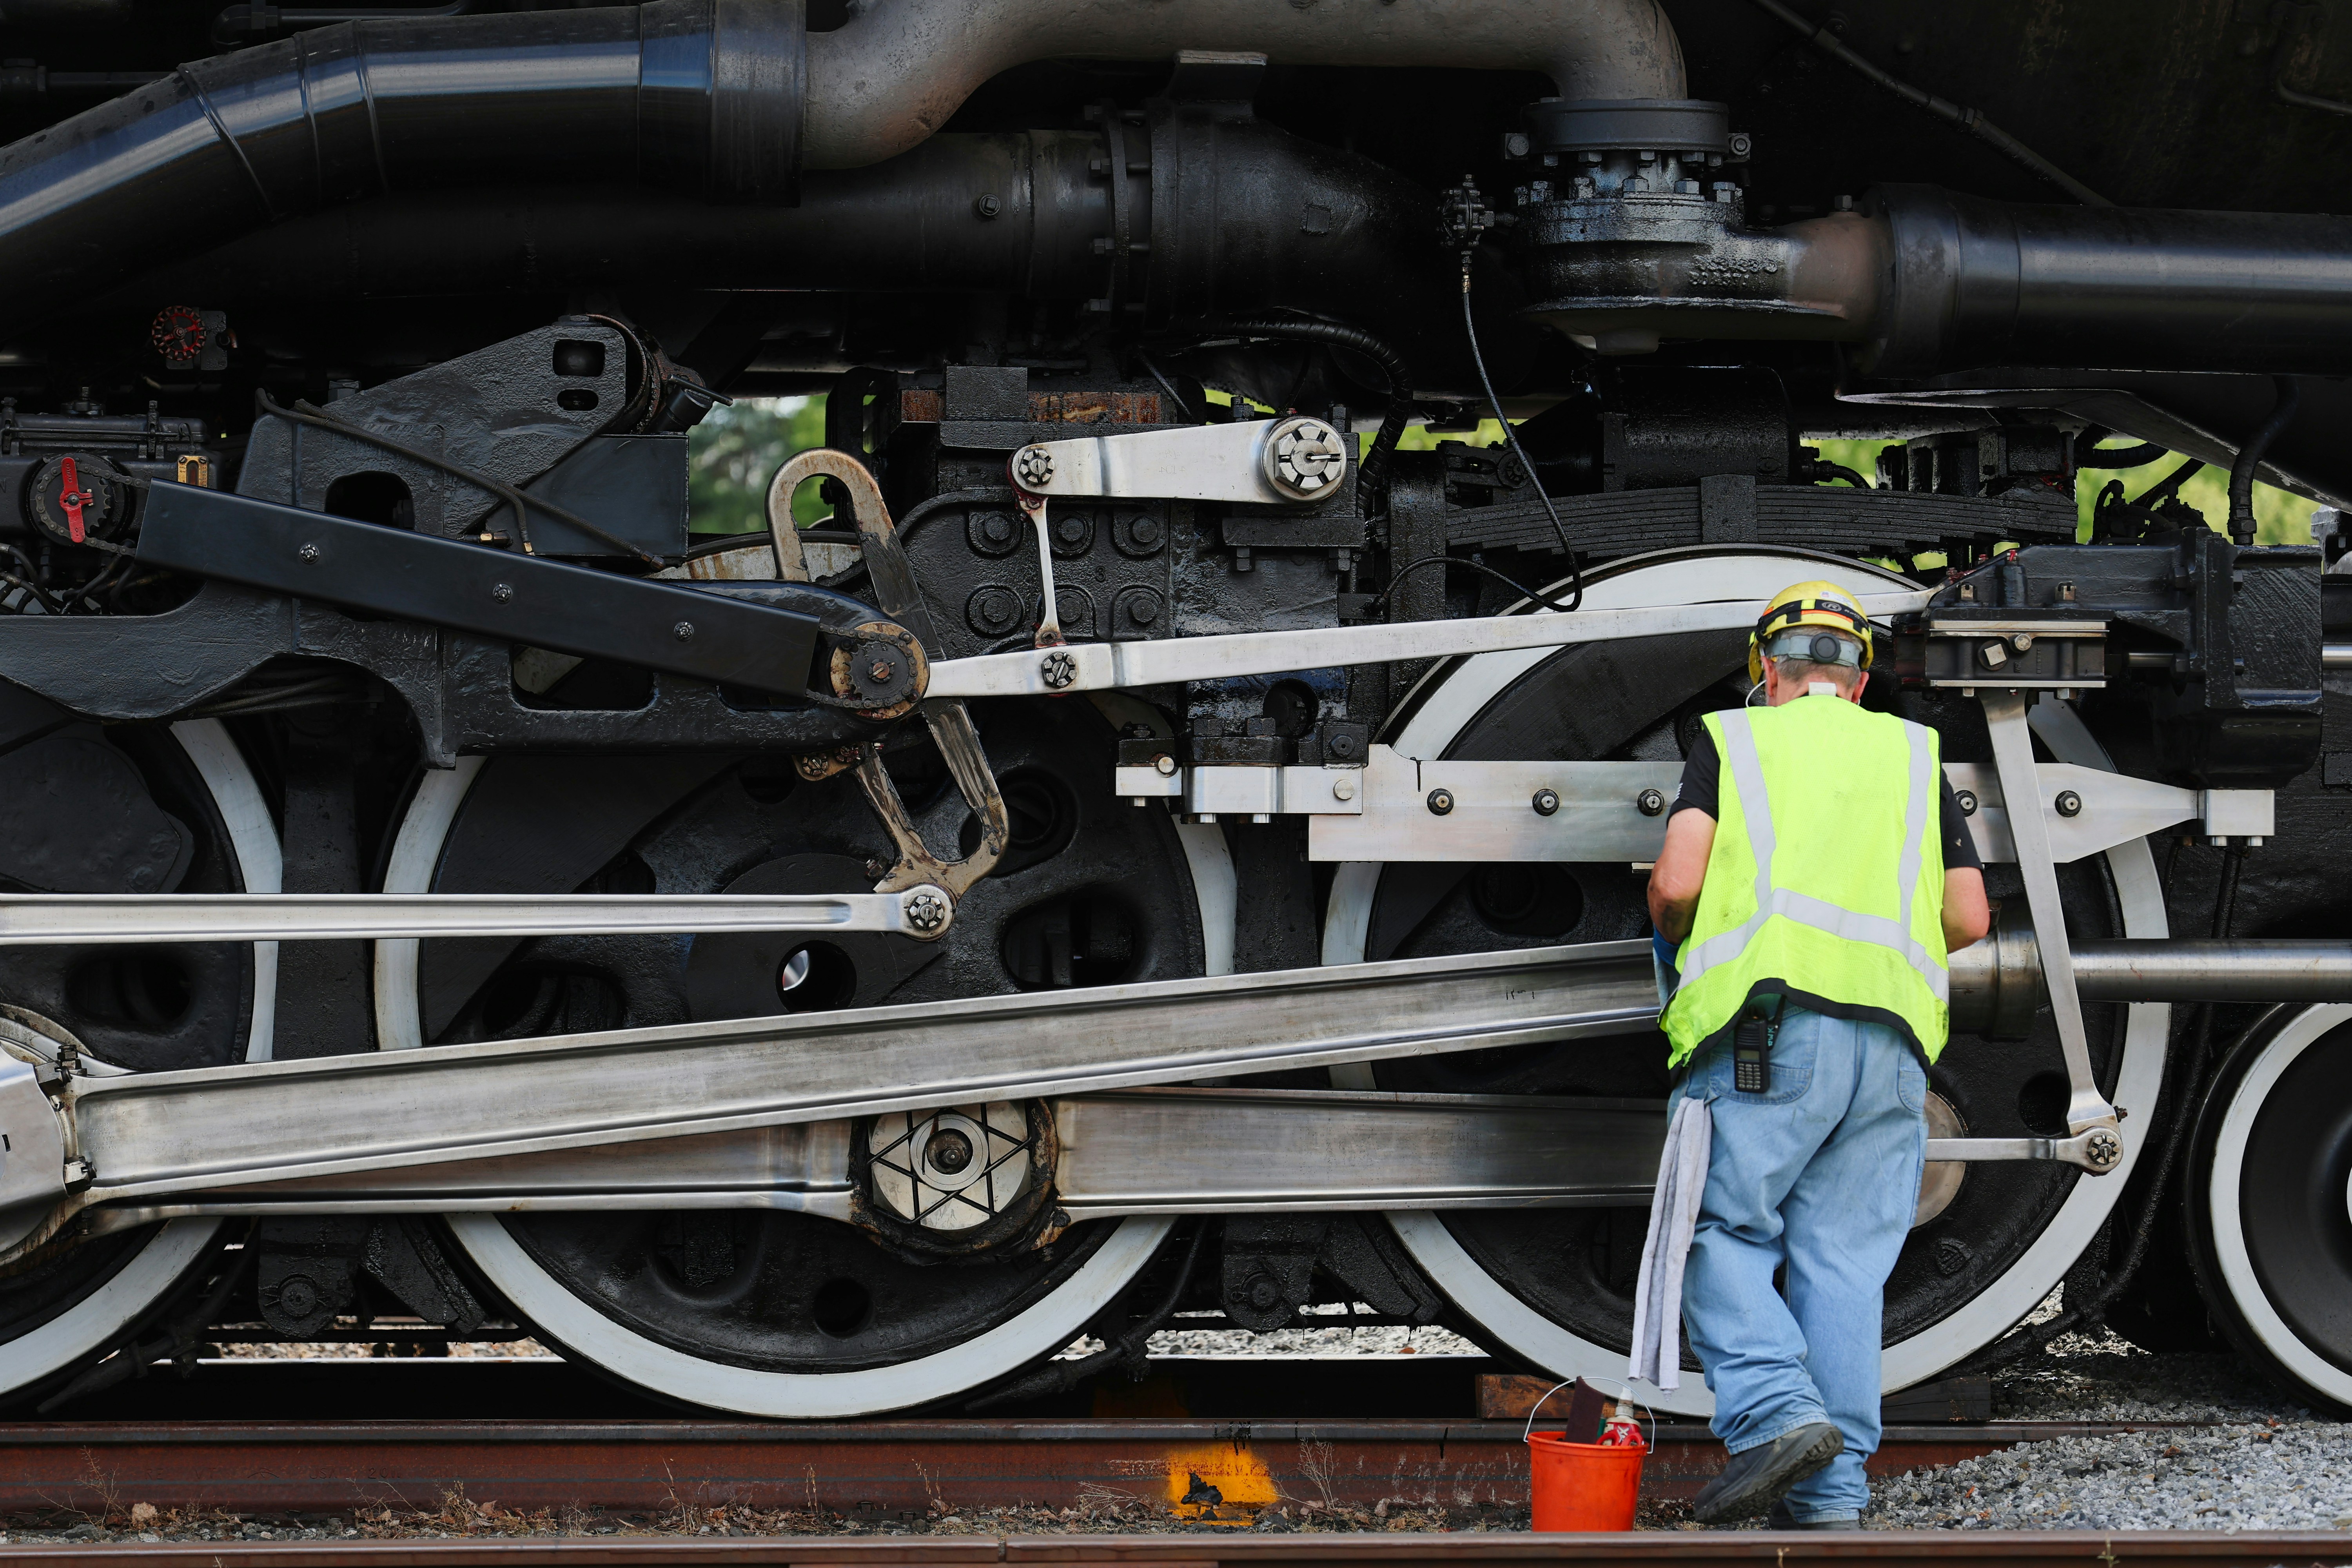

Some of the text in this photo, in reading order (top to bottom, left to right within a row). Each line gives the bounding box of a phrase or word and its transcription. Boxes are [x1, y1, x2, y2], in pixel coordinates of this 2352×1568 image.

[1095, 564, 1106, 583] 3
[145, 1468, 164, 1480] RE
[309, 1467, 338, 1479] USA
[367, 1467, 402, 1479] 2011
